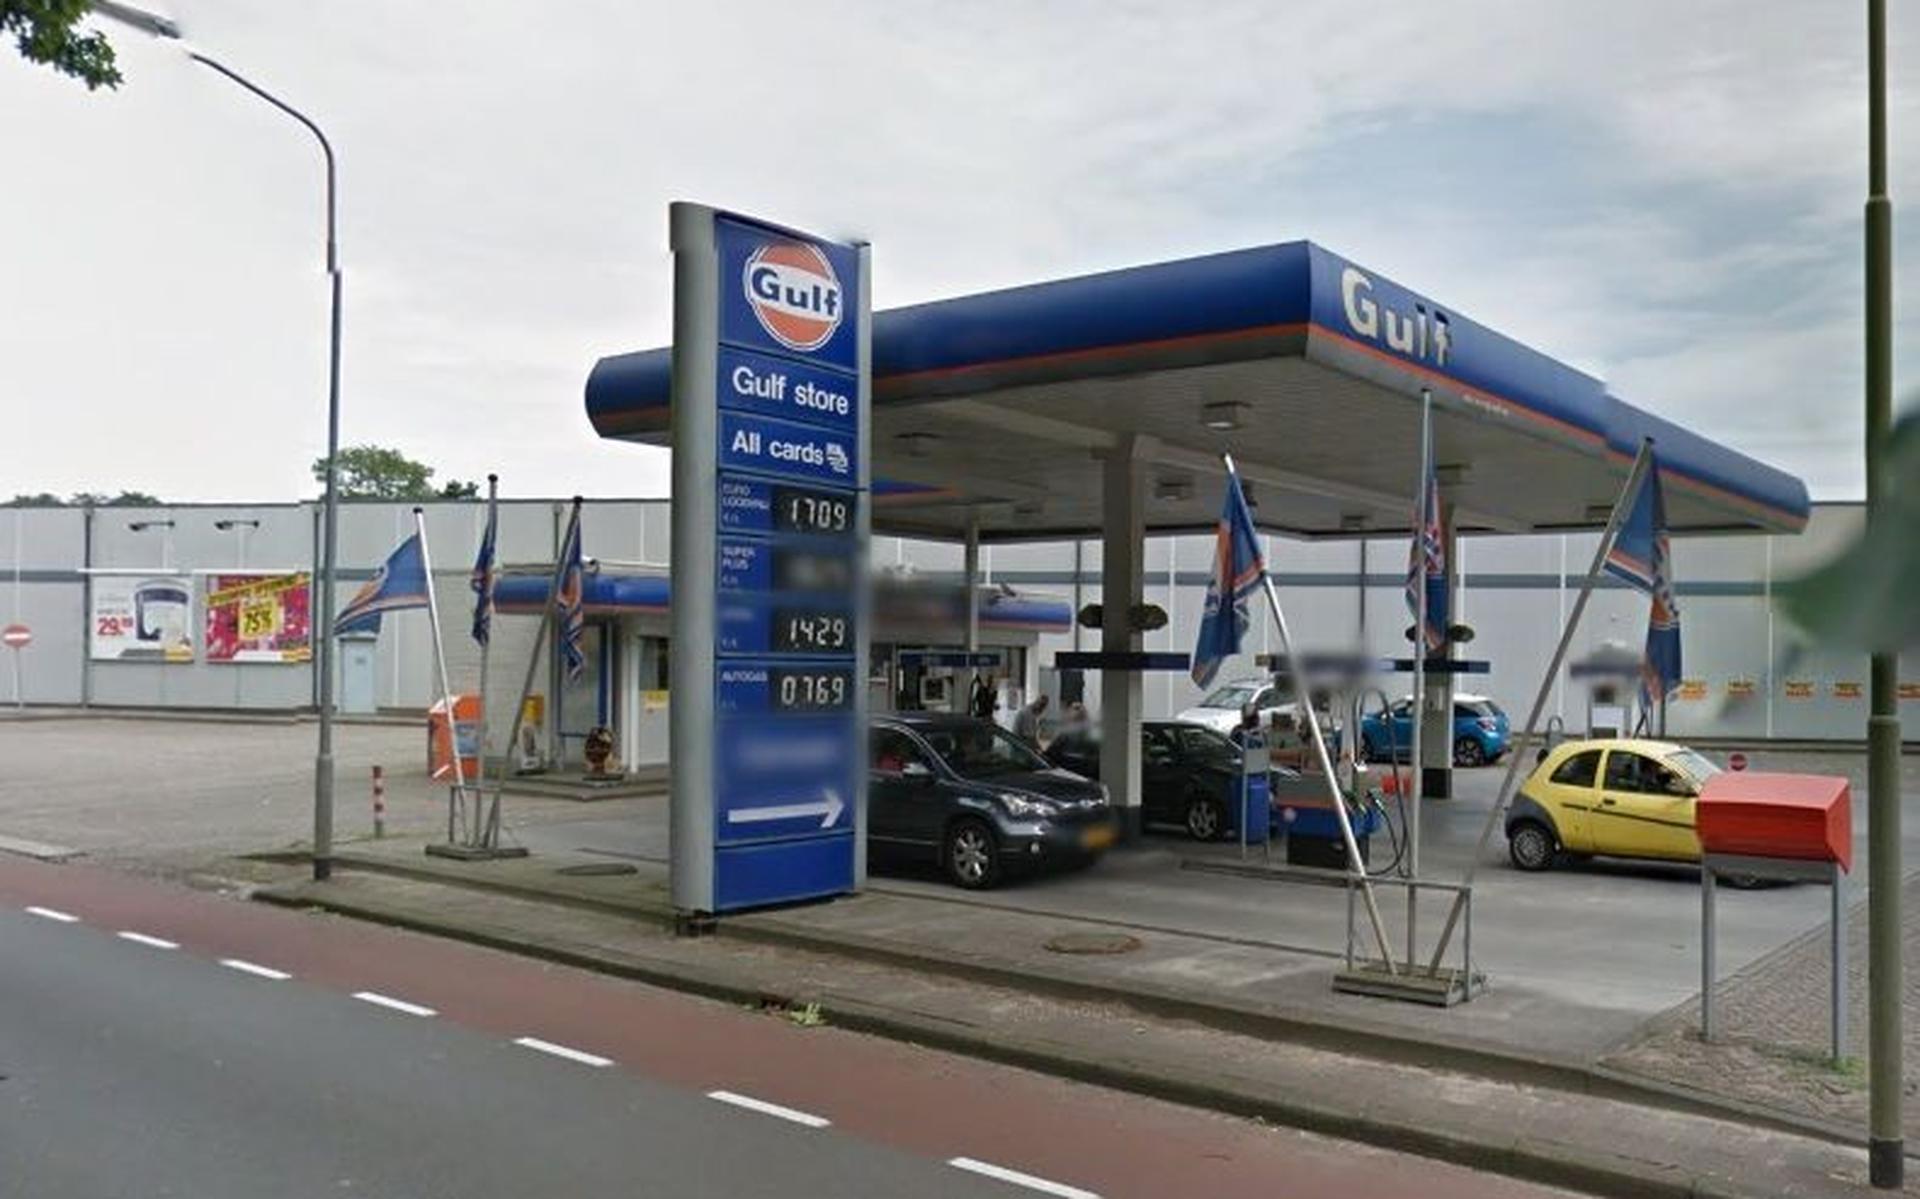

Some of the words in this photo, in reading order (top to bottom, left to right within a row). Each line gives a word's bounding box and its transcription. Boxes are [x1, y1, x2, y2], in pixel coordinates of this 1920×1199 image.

[751, 267, 840, 317] Gulf
[1342, 267, 1449, 367] Gulf
[732, 366, 787, 400] Gulf
[795, 382, 849, 415] store
[732, 430, 761, 454] All
[769, 441, 824, 465] cards
